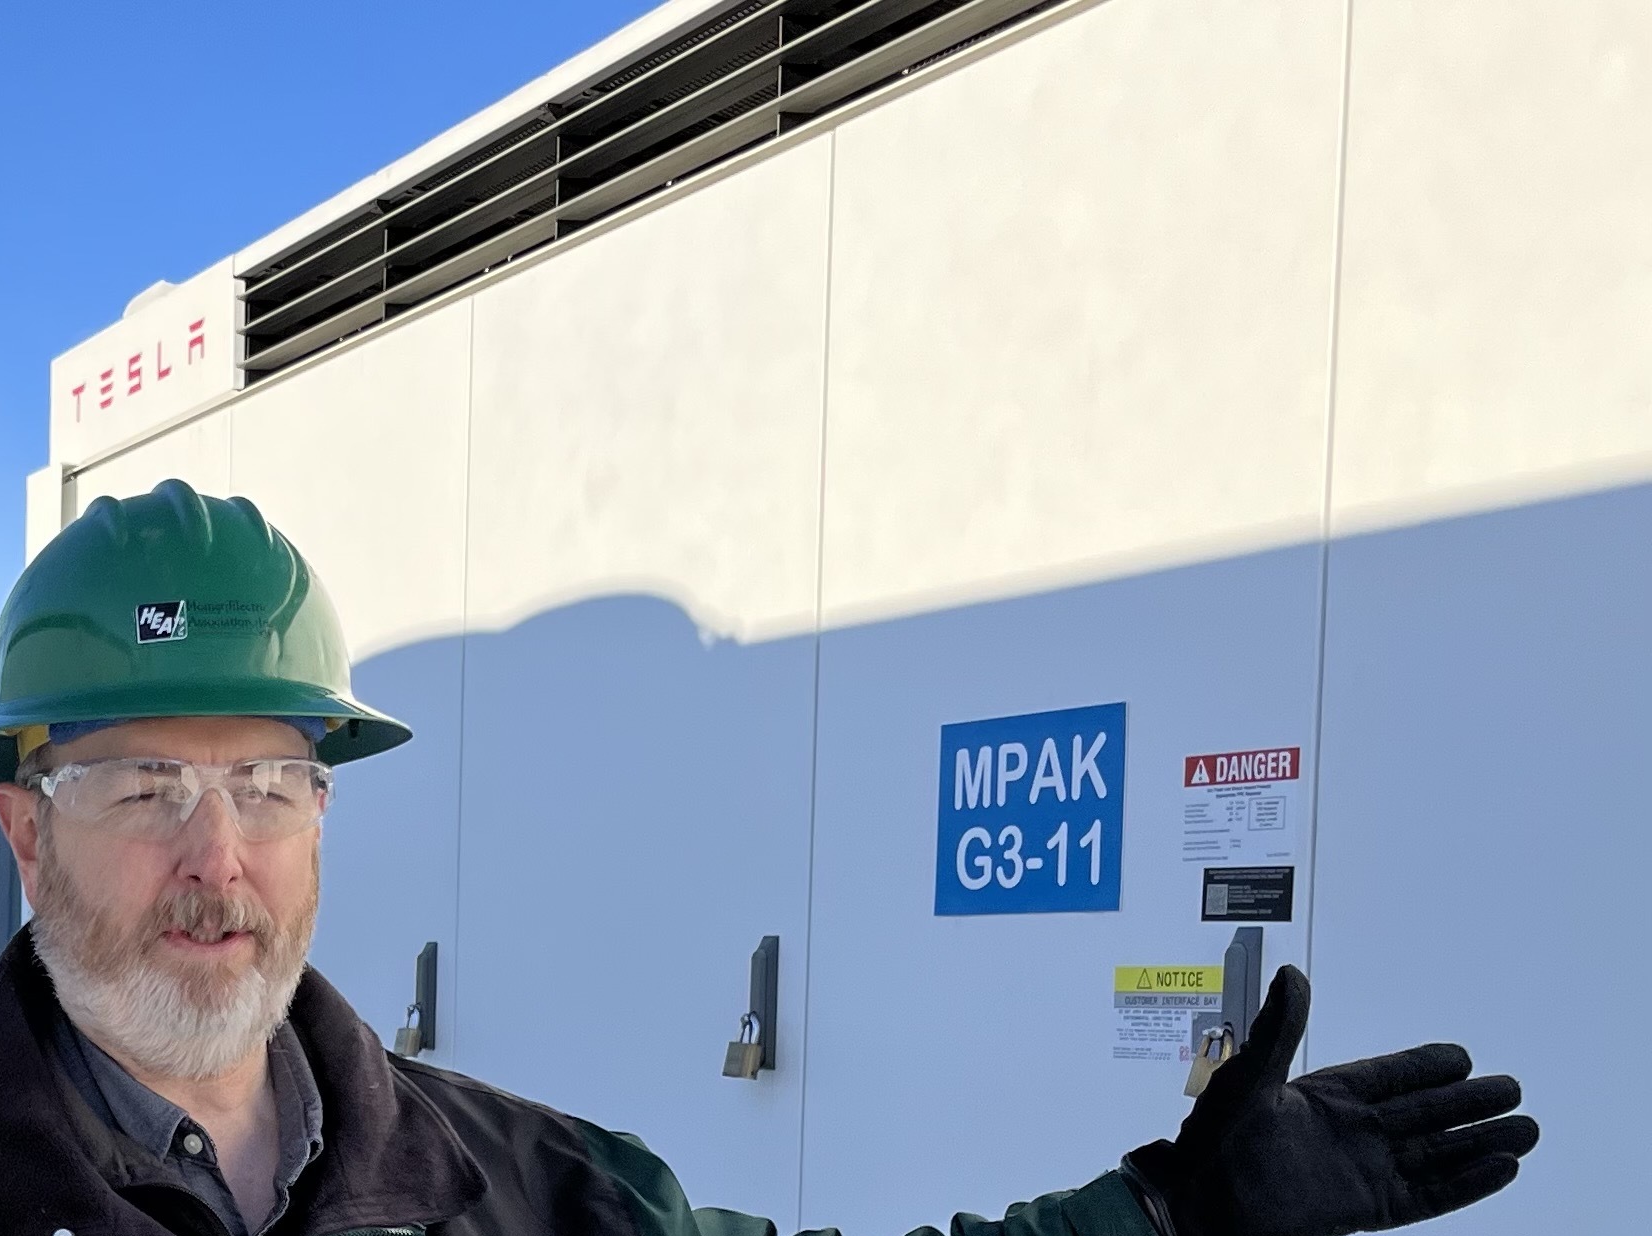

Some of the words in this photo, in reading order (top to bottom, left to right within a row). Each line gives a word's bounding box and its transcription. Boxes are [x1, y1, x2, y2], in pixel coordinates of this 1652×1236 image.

[72, 316, 205, 423] TESLA
[139, 606, 173, 636] HEA
[954, 731, 1107, 811] MPAK
[1216, 751, 1291, 782] DANGER
[956, 818, 1102, 891] G3-11
[1156, 971, 1204, 987] NOTICE
[1124, 995, 1158, 1005] CUSTOMER
[1162, 996, 1200, 1006] INTERFACE
[1203, 996, 1218, 1006] BAY
